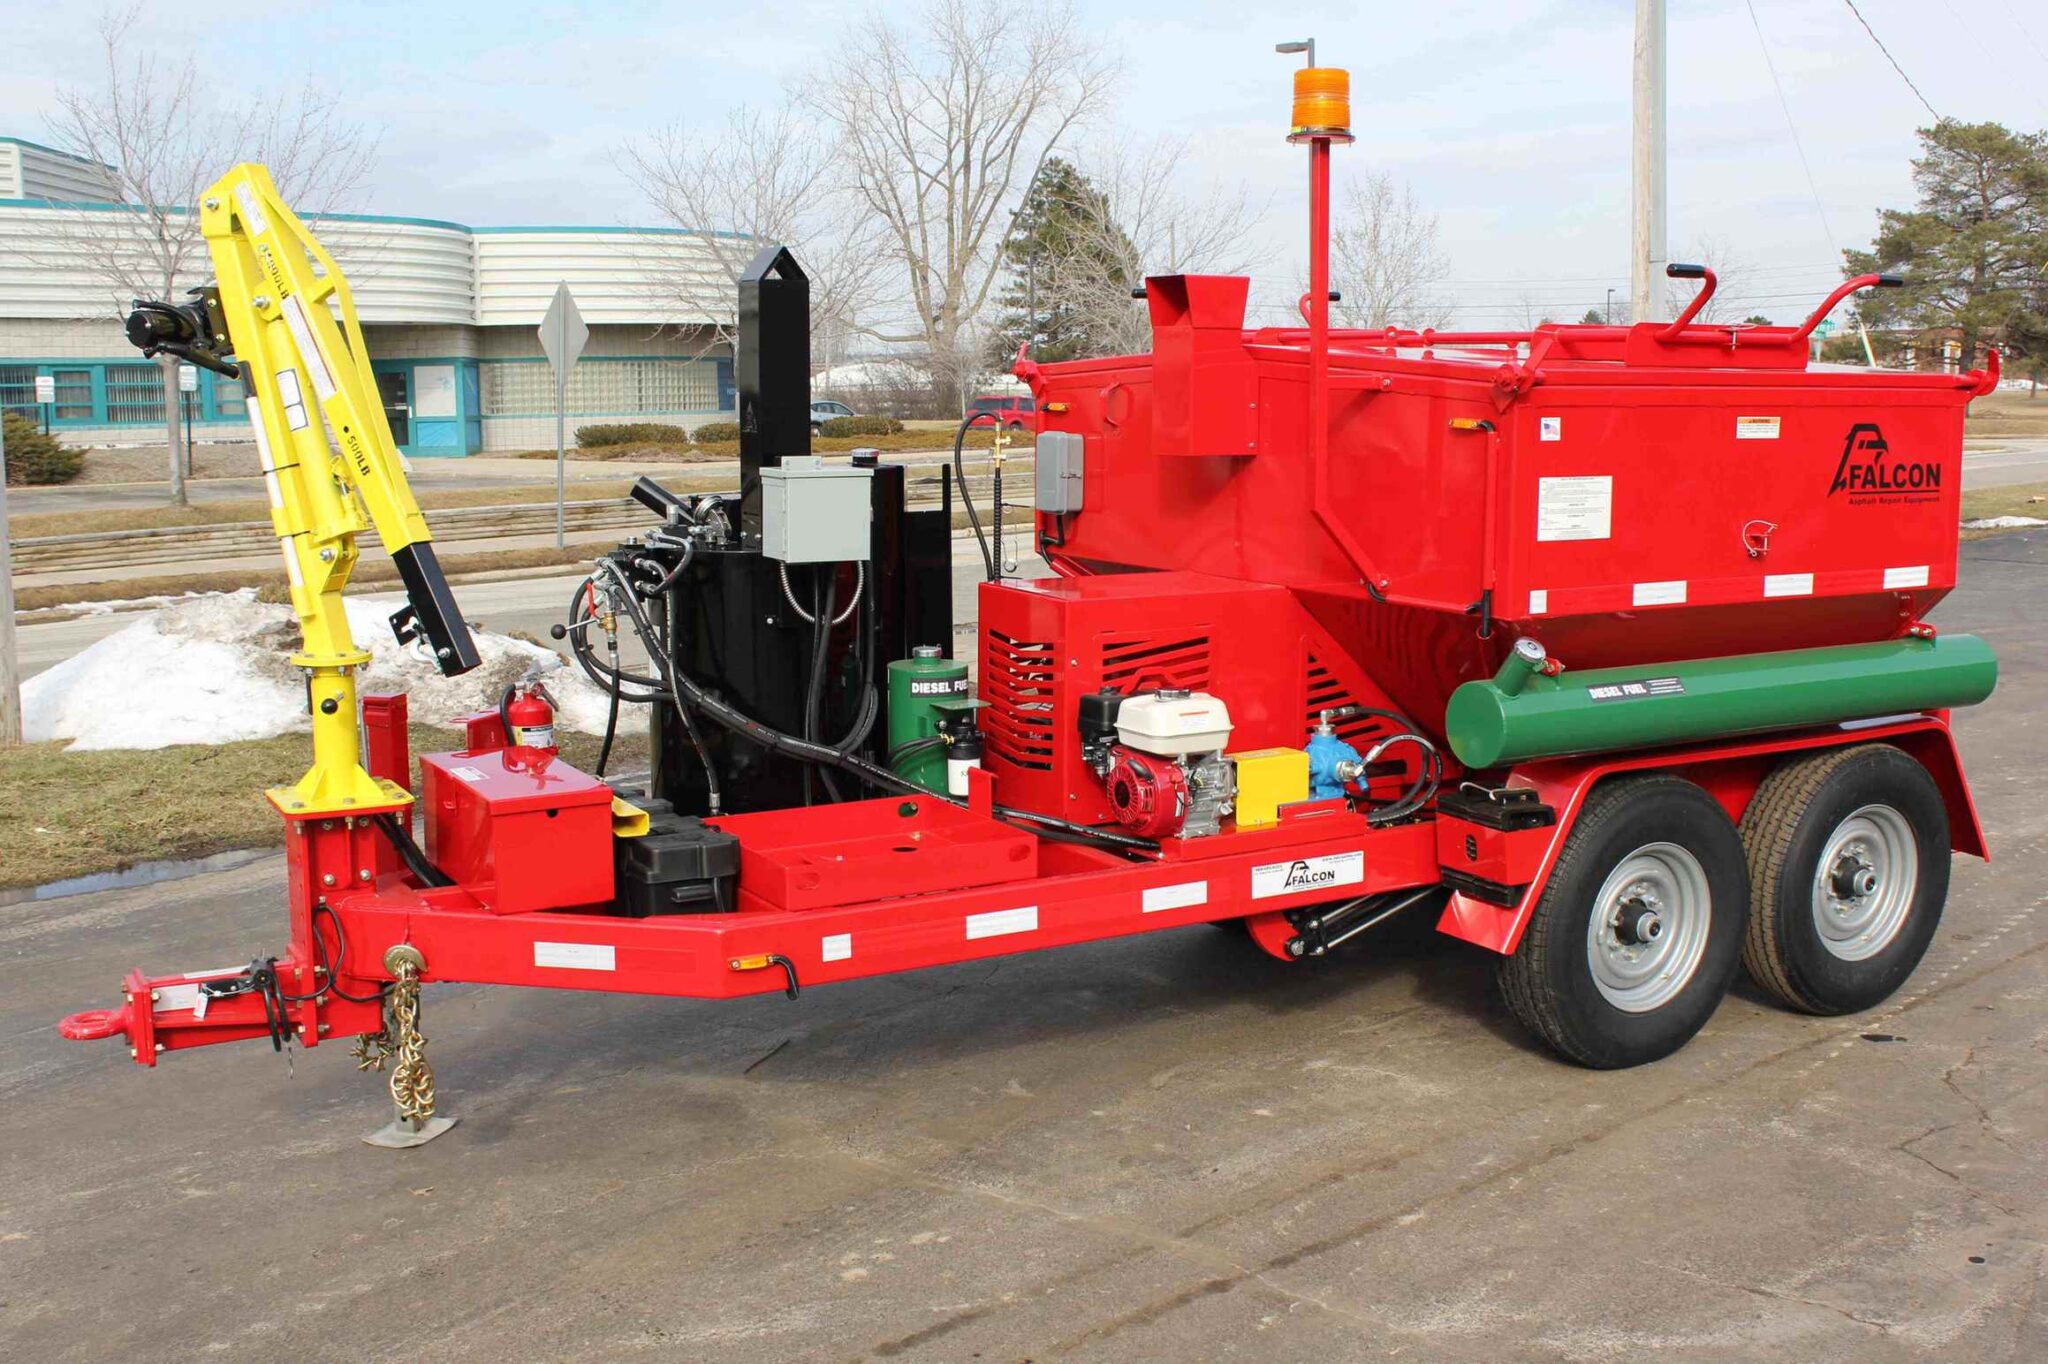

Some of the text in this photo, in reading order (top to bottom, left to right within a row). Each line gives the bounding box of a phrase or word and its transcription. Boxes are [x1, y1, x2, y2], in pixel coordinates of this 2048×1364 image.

[347, 435, 371, 477] 500LB
[1849, 463, 1941, 489] FALCON
[912, 679, 968, 693] DIESEL FUE
[1589, 686, 1623, 698] DIESEL
[1622, 683, 1647, 695] FUEL
[1292, 871, 1335, 885] FALCON
